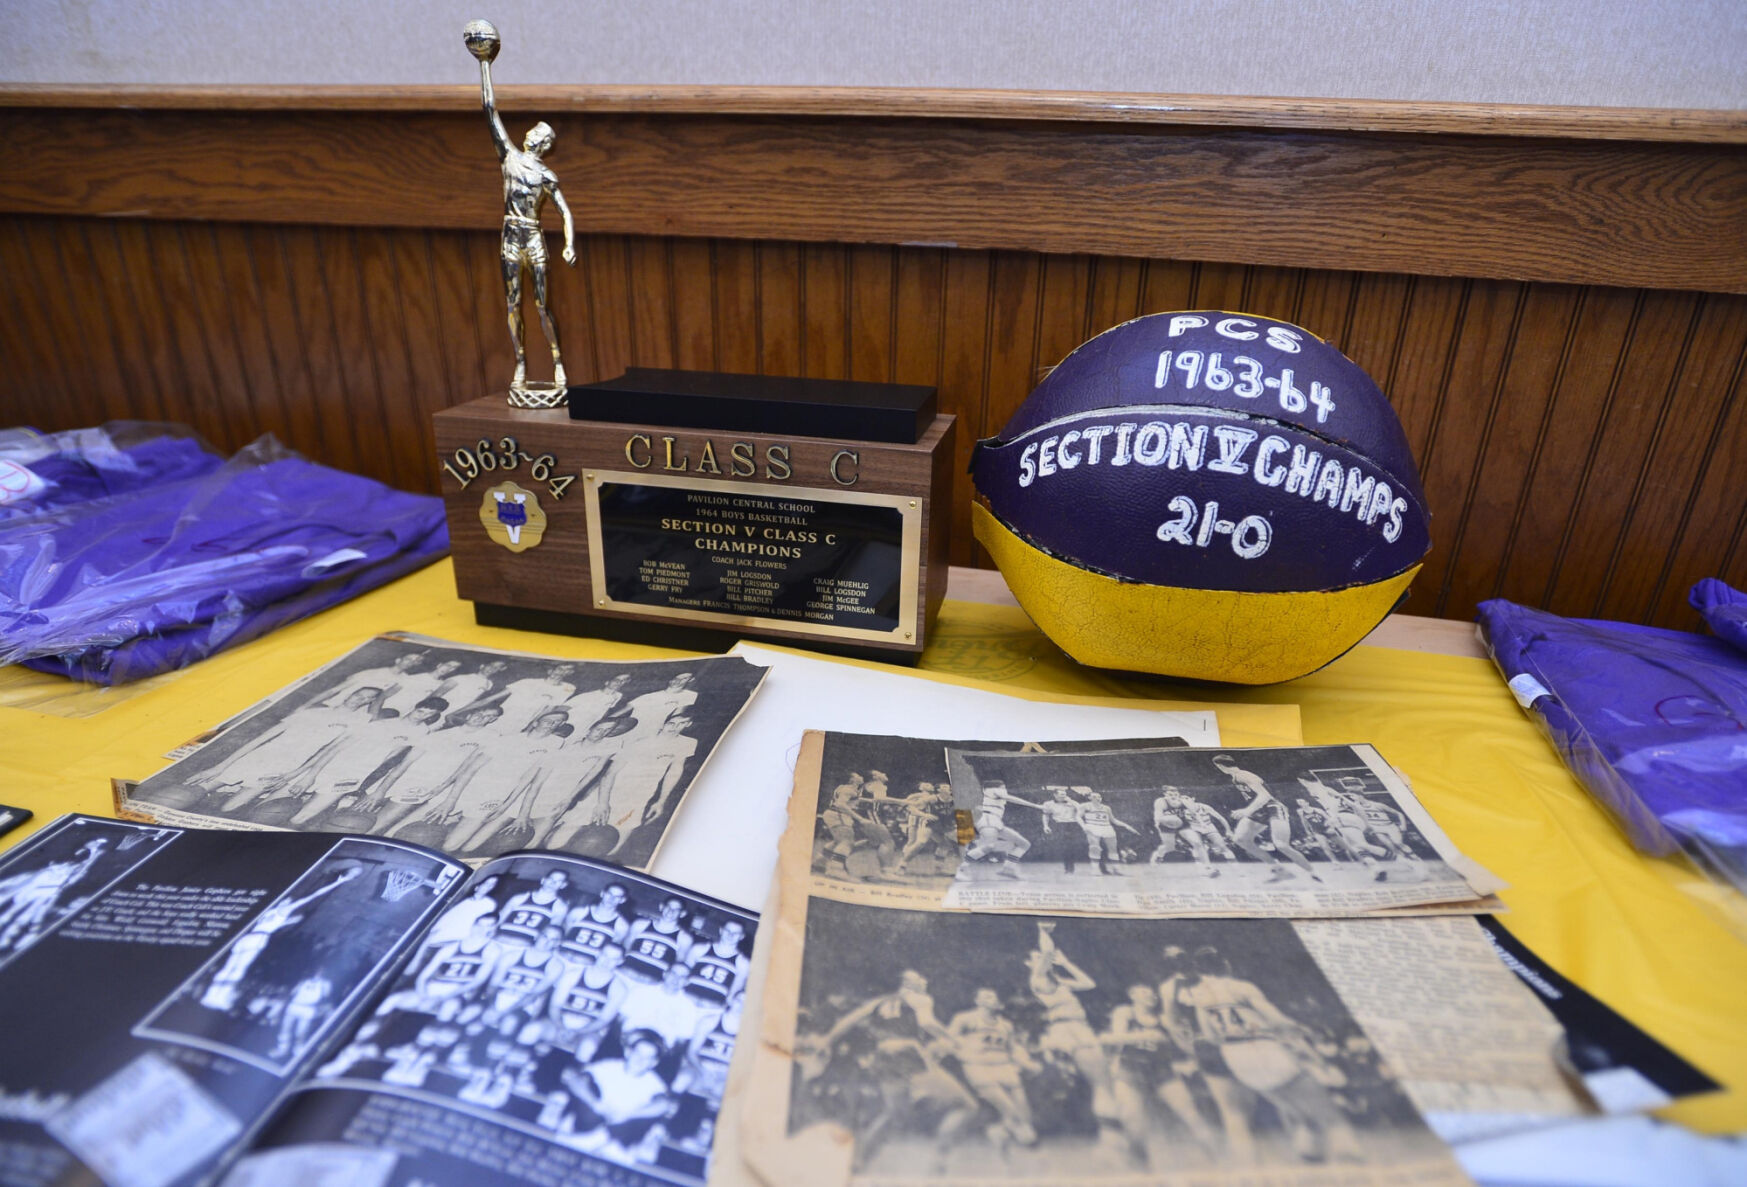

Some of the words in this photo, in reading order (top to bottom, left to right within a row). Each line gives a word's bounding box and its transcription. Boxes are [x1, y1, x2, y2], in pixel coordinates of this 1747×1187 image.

[1169, 315, 1304, 354] PCS
[1154, 350, 1336, 423] 1963-64
[624, 432, 793, 480] CLASS
[829, 448, 860, 486] C
[1018, 421, 1208, 488] SECTION
[1206, 425, 1259, 475] V
[1253, 435, 1408, 544] CHAMPS
[687, 494, 730, 506] PAVILION
[732, 498, 775, 511] CENTRAL
[778, 502, 816, 513] SCHOOL
[695, 508, 718, 518] 1964
[721, 510, 745, 521] BOYS
[748, 512, 809, 526] BASKETBALL
[661, 517, 737, 536] SECTION
[744, 525, 756, 538] V
[763, 528, 818, 544] CLASS
[825, 533, 837, 546] C
[1155, 495, 1273, 560] 21-0
[694, 537, 802, 559] CHAMPIONS
[711, 555, 735, 566] COACH
[736, 557, 754, 567] JACK
[755, 559, 788, 570] FLOWERS
[638, 567, 654, 576] TOM
[655, 568, 691, 579] PIEDMONT
[652, 576, 689, 587] CHRISTNER
[726, 569, 738, 578] JIM
[740, 570, 772, 581] LOGSDON
[719, 576, 742, 586] ROGER
[744, 579, 780, 590] GRISWOLD
[744, 586, 773, 597] PITCHER
[812, 577, 835, 587] CRAIG
[837, 580, 869, 590] MUEHLIG
[815, 585, 831, 594] BILL
[833, 587, 867, 598] LOGSDON
[743, 594, 774, 605] BRADLEY
[806, 600, 834, 610] GEORGE
[835, 603, 876, 615] SPINNEGAN
[836, 596, 860, 605] McGEE
[733, 603, 770, 614] THOMPSON
[804, 611, 834, 620] MORGAN
[513, 911, 544, 929] 33
[575, 928, 605, 949] 53
[640, 940, 668, 960] 55
[446, 963, 472, 978] 21
[700, 964, 729, 985] 45
